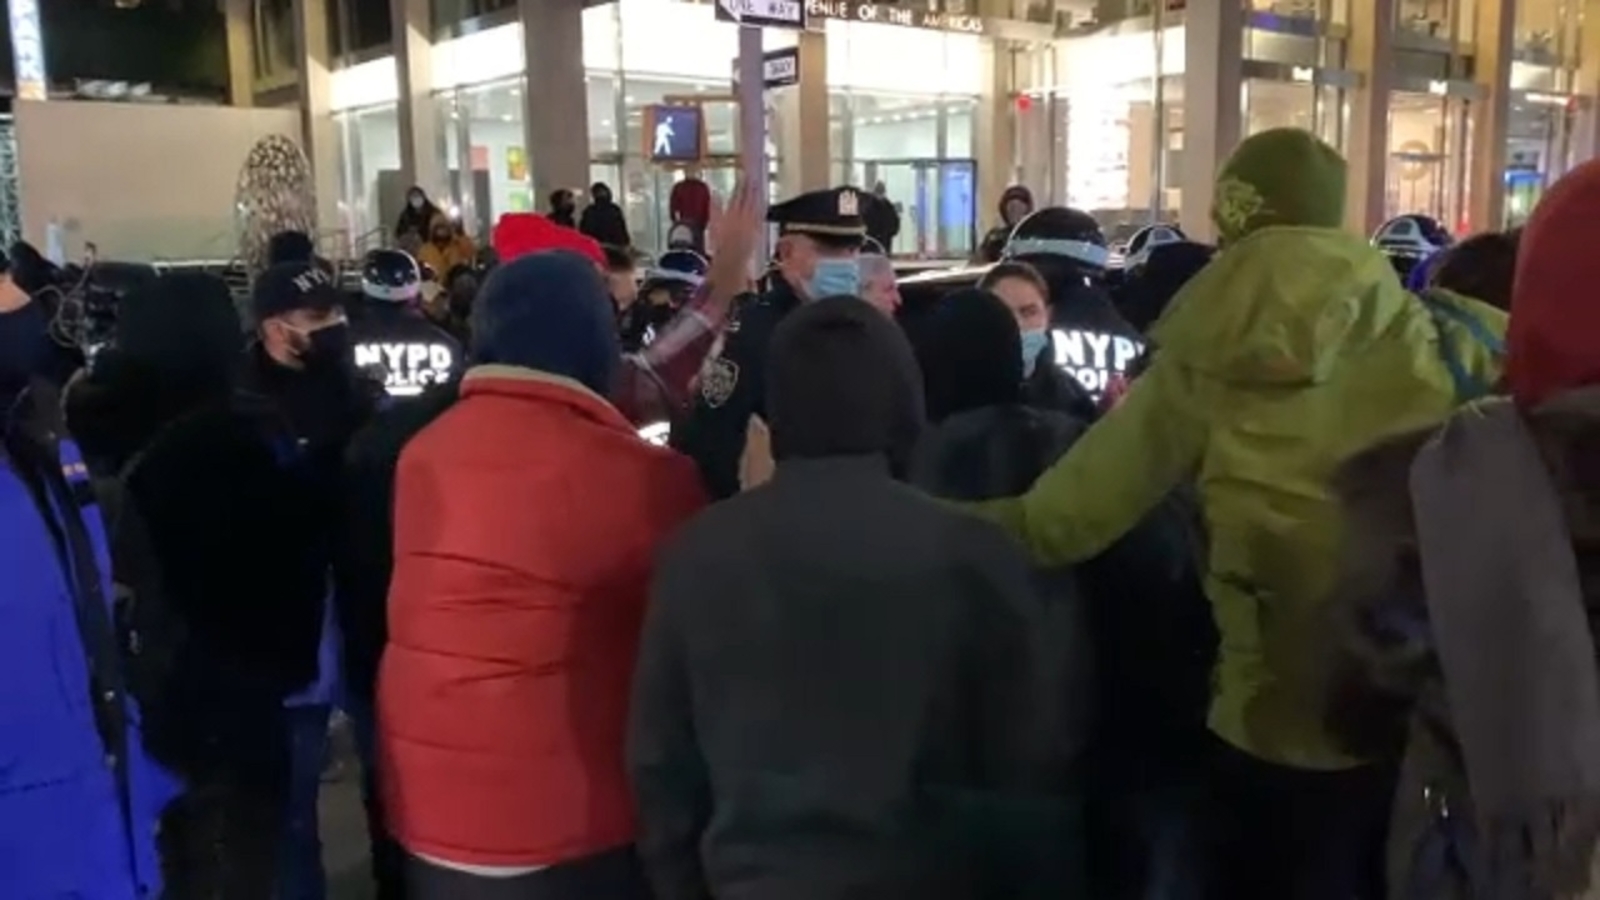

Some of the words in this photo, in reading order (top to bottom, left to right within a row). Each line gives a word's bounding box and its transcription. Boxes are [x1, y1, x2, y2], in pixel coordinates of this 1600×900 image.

[857, 4, 878, 20] OF
[888, 7, 913, 26] THE
[354, 342, 452, 370] NYPD
[1051, 329, 1146, 371] NYP
